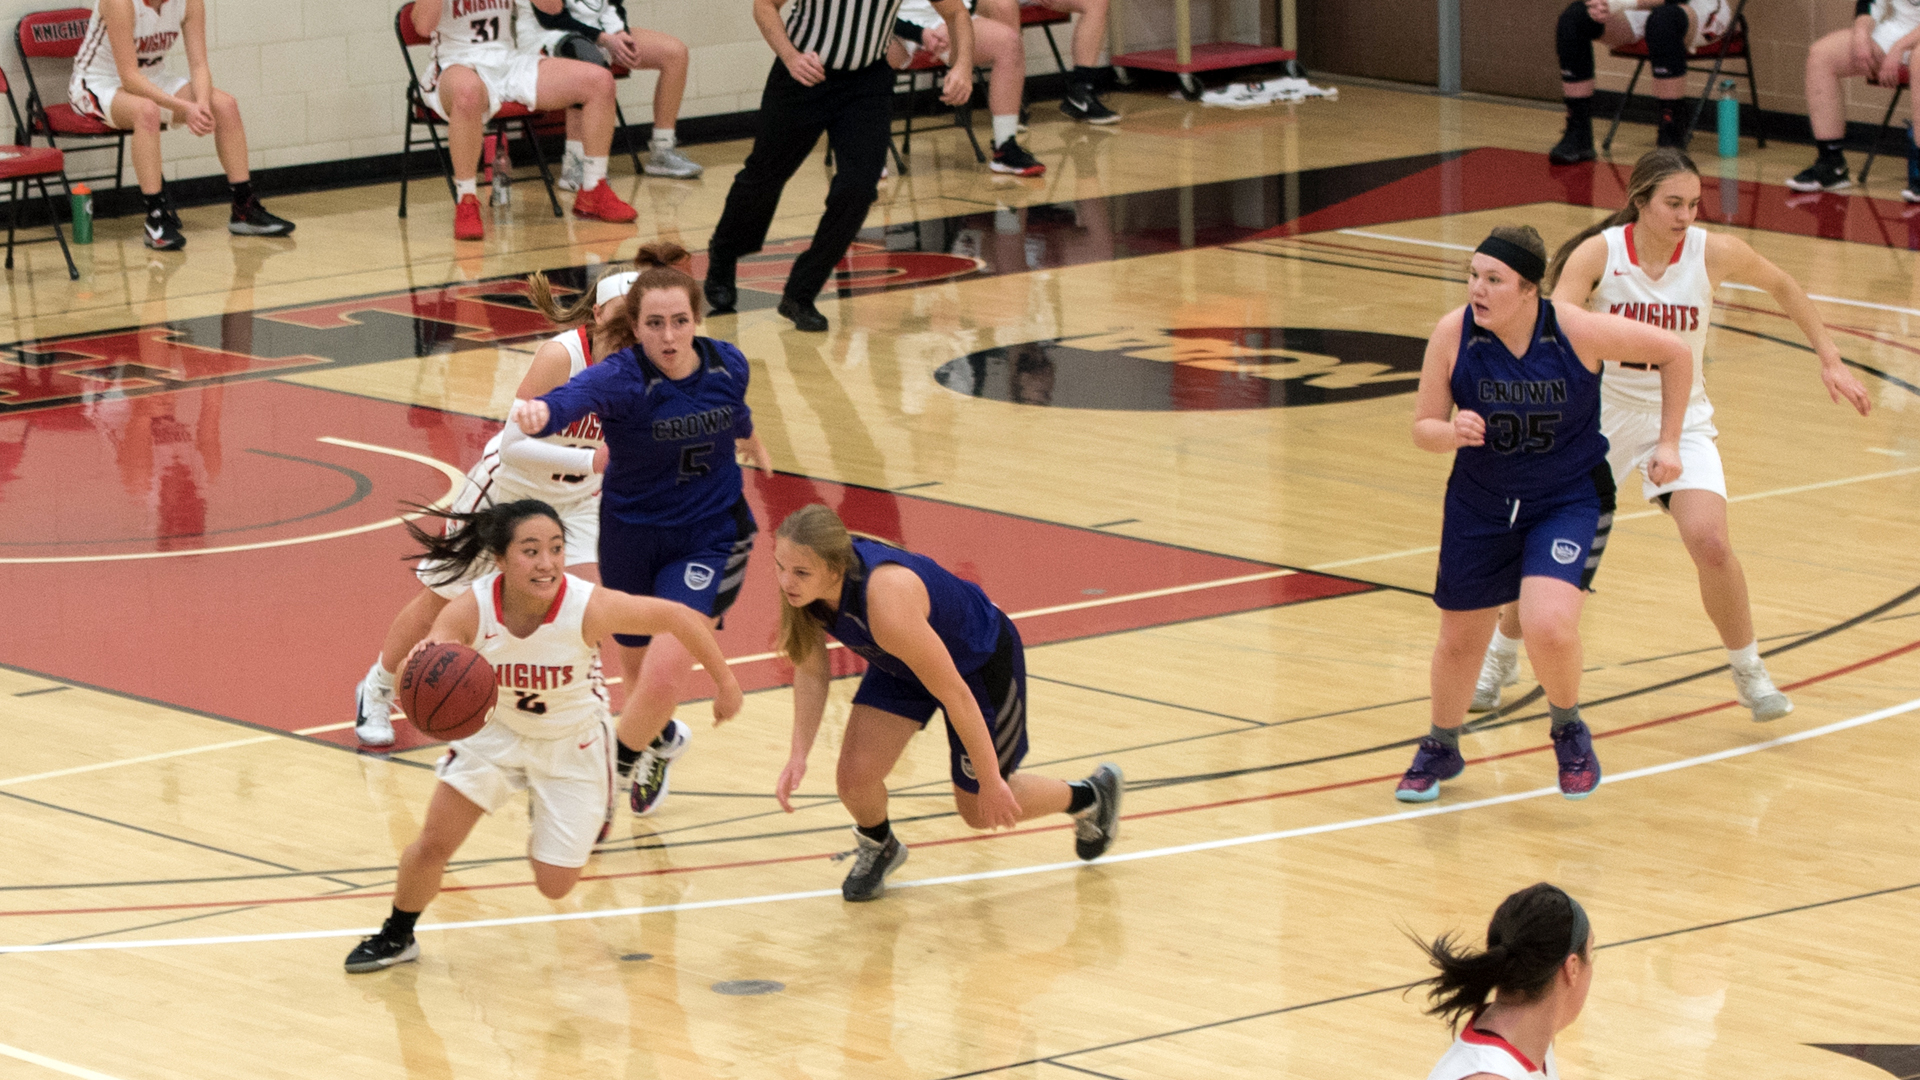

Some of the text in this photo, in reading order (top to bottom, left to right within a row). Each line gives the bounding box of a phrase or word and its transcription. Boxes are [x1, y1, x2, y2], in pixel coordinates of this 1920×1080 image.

[470, 16, 499, 43] 31
[1478, 378, 1567, 404] CROWN
[652, 405, 733, 441] CROWN
[1488, 410, 1562, 455] 35
[676, 442, 715, 486] 5
[425, 651, 460, 689] NCAA
[491, 664, 574, 690] NIGHTS
[514, 690, 547, 715] 2
